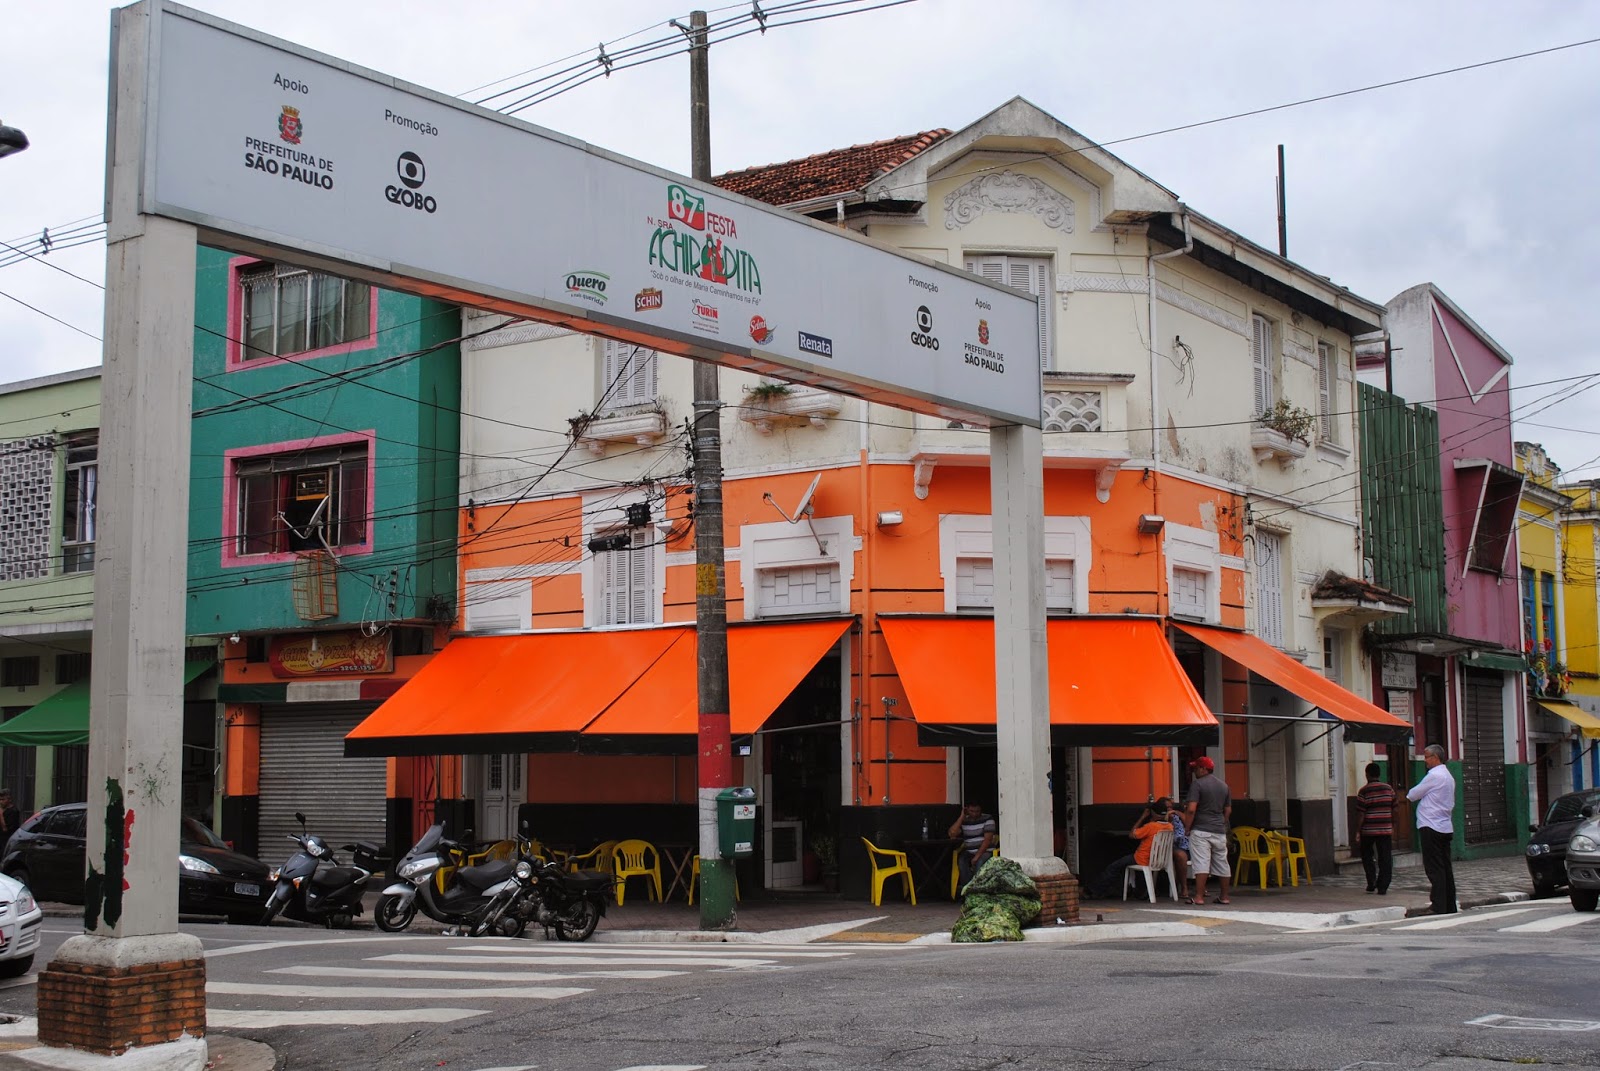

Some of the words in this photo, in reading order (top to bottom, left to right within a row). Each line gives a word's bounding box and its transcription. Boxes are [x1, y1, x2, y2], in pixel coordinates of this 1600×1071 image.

[274, 73, 309, 94] Apoio
[385, 109, 438, 136] Promoção
[246, 137, 315, 167] PREFEITURA
[319, 157, 333, 172] DE
[245, 153, 279, 175] SÃO
[282, 163, 333, 190] PAULO
[385, 184, 437, 213] GLOBO
[647, 216, 656, 226] N.
[707, 212, 737, 239] FESTA
[566, 275, 606, 292] Quero
[670, 275, 684, 286] olhar
[685, 279, 693, 288] de
[693, 281, 708, 292] Maria
[909, 275, 939, 293] Promoção
[637, 294, 660, 308] SCHIN
[975, 298, 991, 311] Apoio
[696, 305, 718, 319] TURIN
[800, 333, 832, 355] Renata
[911, 331, 940, 351] GLOBO
[964, 342, 996, 360] PREFEITURA
[997, 353, 1004, 361] DE
[964, 353, 980, 367] SÃO
[981, 358, 1004, 374] PAULO
